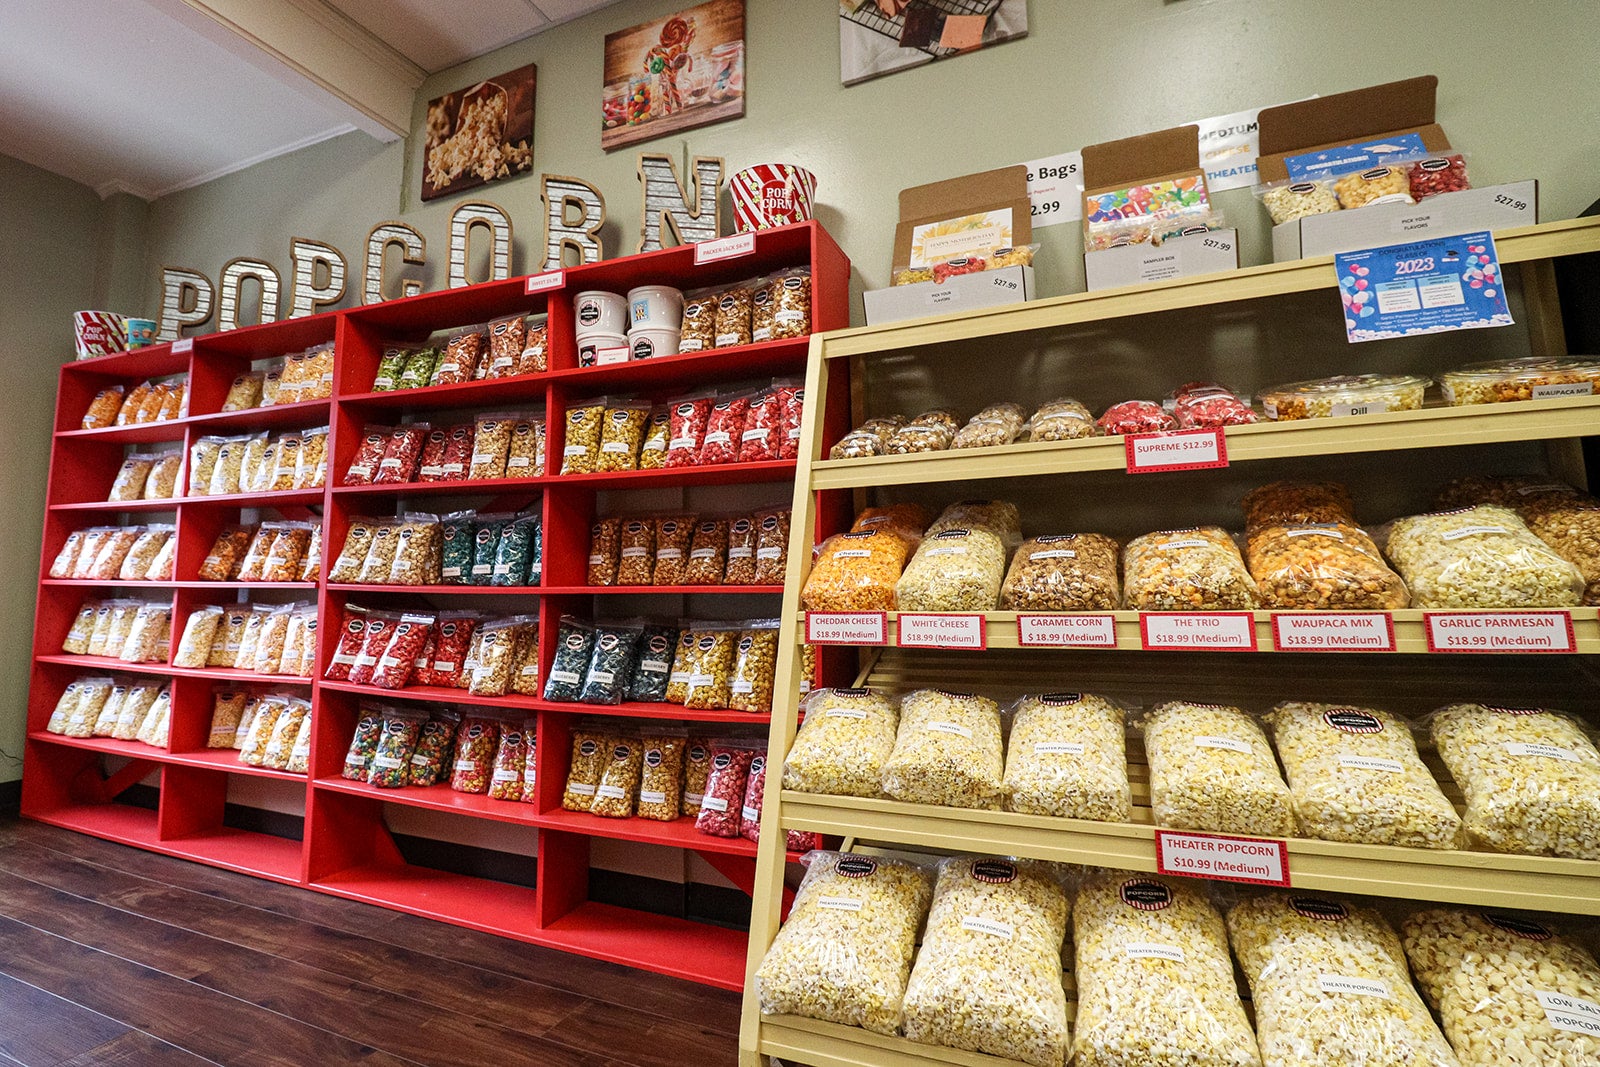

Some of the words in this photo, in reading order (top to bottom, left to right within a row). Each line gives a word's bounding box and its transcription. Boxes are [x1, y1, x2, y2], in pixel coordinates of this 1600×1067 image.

[1205, 144, 1251, 160] CHEESE
[1039, 164, 1077, 180] Bags
[1207, 164, 1259, 180] THEATER
[766, 186, 791, 200] POP
[761, 196, 793, 211] CORN
[1031, 200, 1061, 216] 2.99
[1494, 194, 1528, 211] $27.99
[1401, 218, 1414, 226] PICK
[1404, 223, 1429, 231] FLAVORS
[155, 152, 725, 342] POPCORN
[702, 247, 721, 256] PACKER
[1203, 239, 1231, 252] $27.99
[1395, 257, 1435, 275] 2023
[993, 278, 1017, 290] $27.99
[86, 326, 103, 334] POP
[83, 332, 105, 342] CORN
[1538, 388, 1575, 398] WAUPACA
[1576, 387, 1589, 395] MIX
[1351, 407, 1368, 417] Dill
[1137, 442, 1181, 453] SUPREME
[1183, 440, 1214, 451] $12.99
[815, 616, 850, 626] CHEDDAR
[851, 616, 878, 626] CHEESE
[911, 620, 938, 630] WHITE
[939, 620, 970, 630] CHEESE
[1030, 618, 1074, 628] CARAMEL
[1076, 618, 1103, 628] CORN
[1173, 619, 1193, 628] THE
[1194, 619, 1220, 628] TRIO
[1290, 619, 1348, 629] WAUPACA
[1350, 619, 1373, 629] MIX
[1438, 618, 1482, 629] GARLIC
[1484, 618, 1554, 628] PARMESAN
[816, 630, 840, 640] $18.99
[841, 630, 878, 641] (Medium)
[906, 633, 934, 643] $18.99
[935, 634, 975, 645] (Medium)
[1035, 633, 1060, 643] 18.99
[1061, 633, 1107, 644] (Medium)
[1155, 633, 1188, 644] $18.99
[1189, 634, 1242, 645] (Medium)
[1286, 635, 1323, 645] $18.99
[1326, 635, 1382, 647] (Medium)
[1446, 635, 1487, 646] $18.99
[1489, 635, 1551, 648] (Medium)
[939, 724, 960, 733] THEATER
[1208, 739, 1235, 748] THEATER
[1525, 743, 1558, 753] THEATER
[1525, 750, 1563, 759] POPCORN
[1341, 759, 1369, 768] THEATER
[1370, 761, 1401, 771] POPCORN
[1167, 839, 1215, 853] THEATER
[1217, 843, 1275, 857] POPCORN
[976, 866, 1011, 874] POPCORN
[1173, 856, 1211, 870] $10.99
[1213, 859, 1271, 876] (Medium)
[964, 920, 986, 930] THEATER
[986, 925, 1011, 937] POPCORN
[1127, 948, 1152, 956] THEATER
[1152, 949, 1182, 959] POPCORN
[1321, 980, 1349, 991] THEATER
[1349, 984, 1385, 995] POPCORN
[1546, 995, 1573, 1009] LOW
[1554, 1015, 1600, 1032] POPCOR
